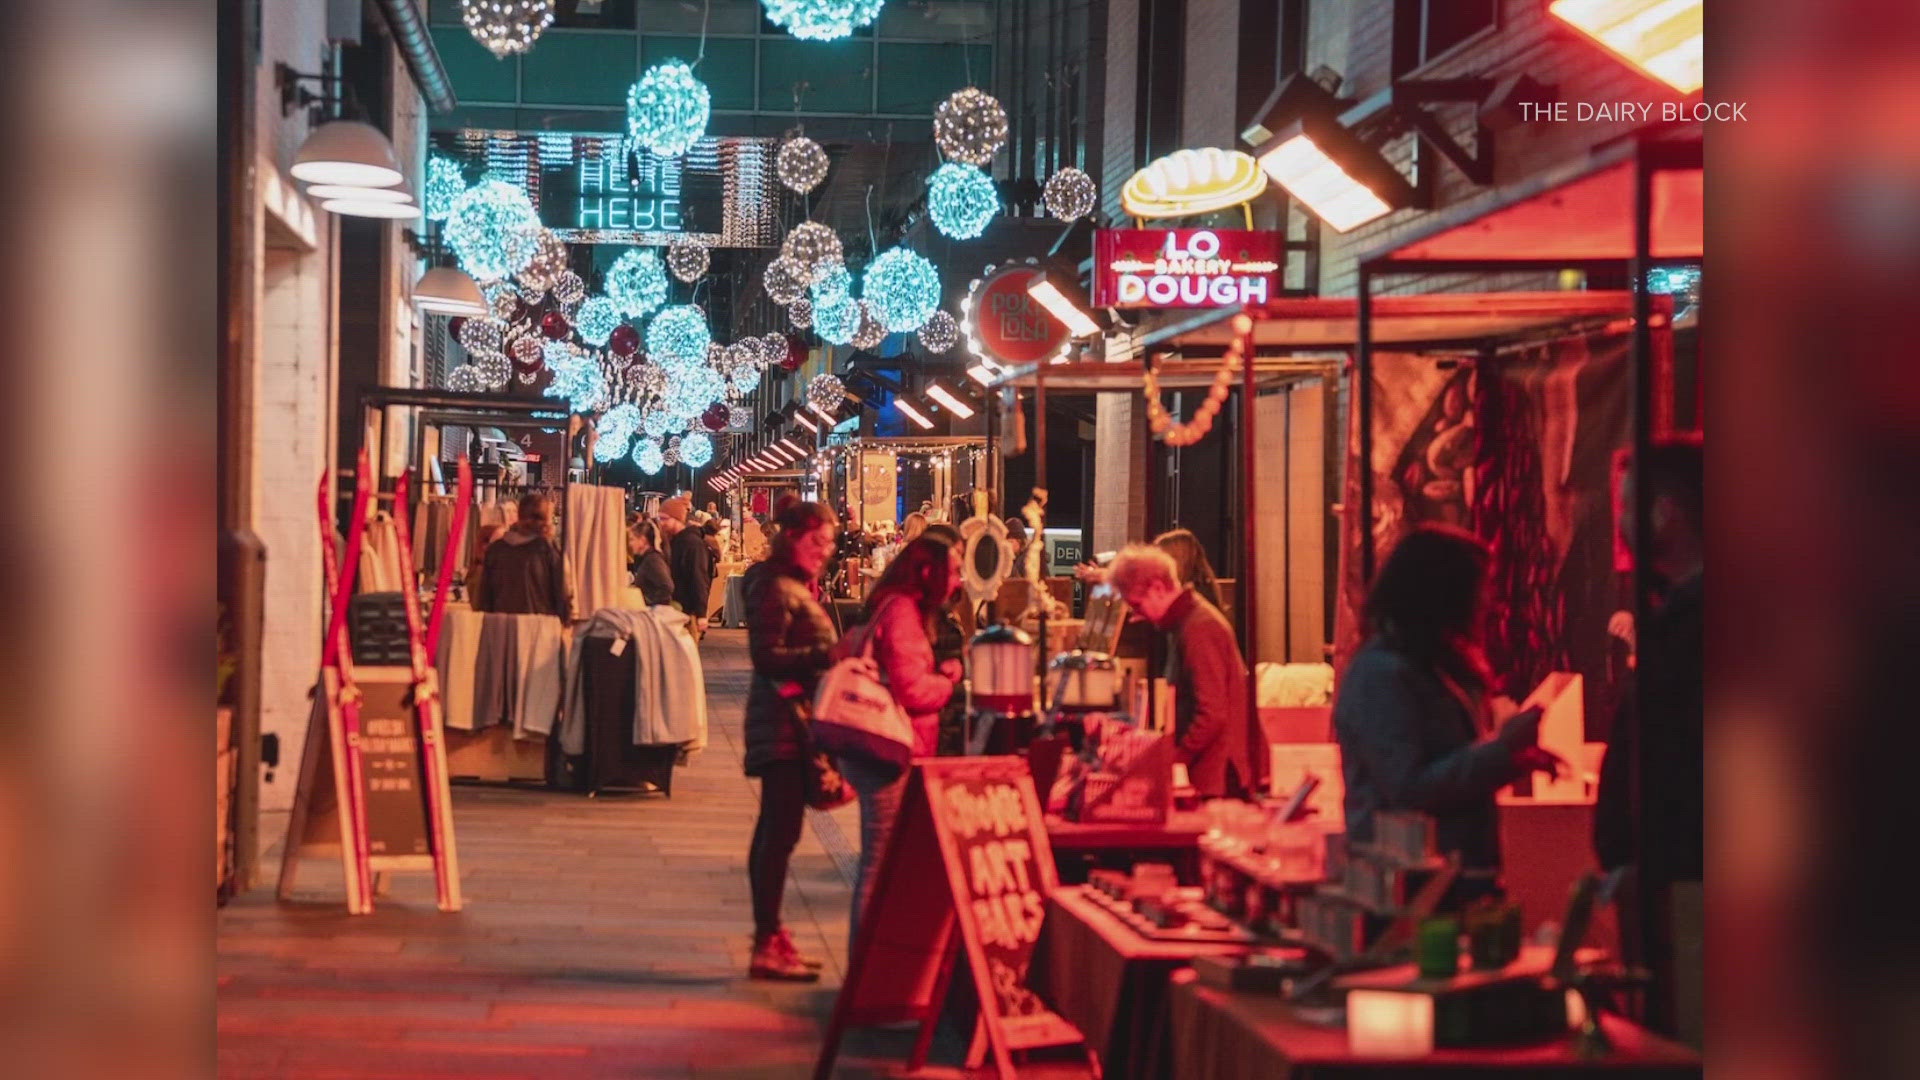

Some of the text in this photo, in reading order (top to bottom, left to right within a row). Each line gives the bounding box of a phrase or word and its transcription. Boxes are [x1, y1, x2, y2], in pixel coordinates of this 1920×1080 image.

[1165, 230, 1221, 260] LO
[1154, 258, 1232, 274] BAKERY
[1118, 274, 1268, 305] DOUGH
